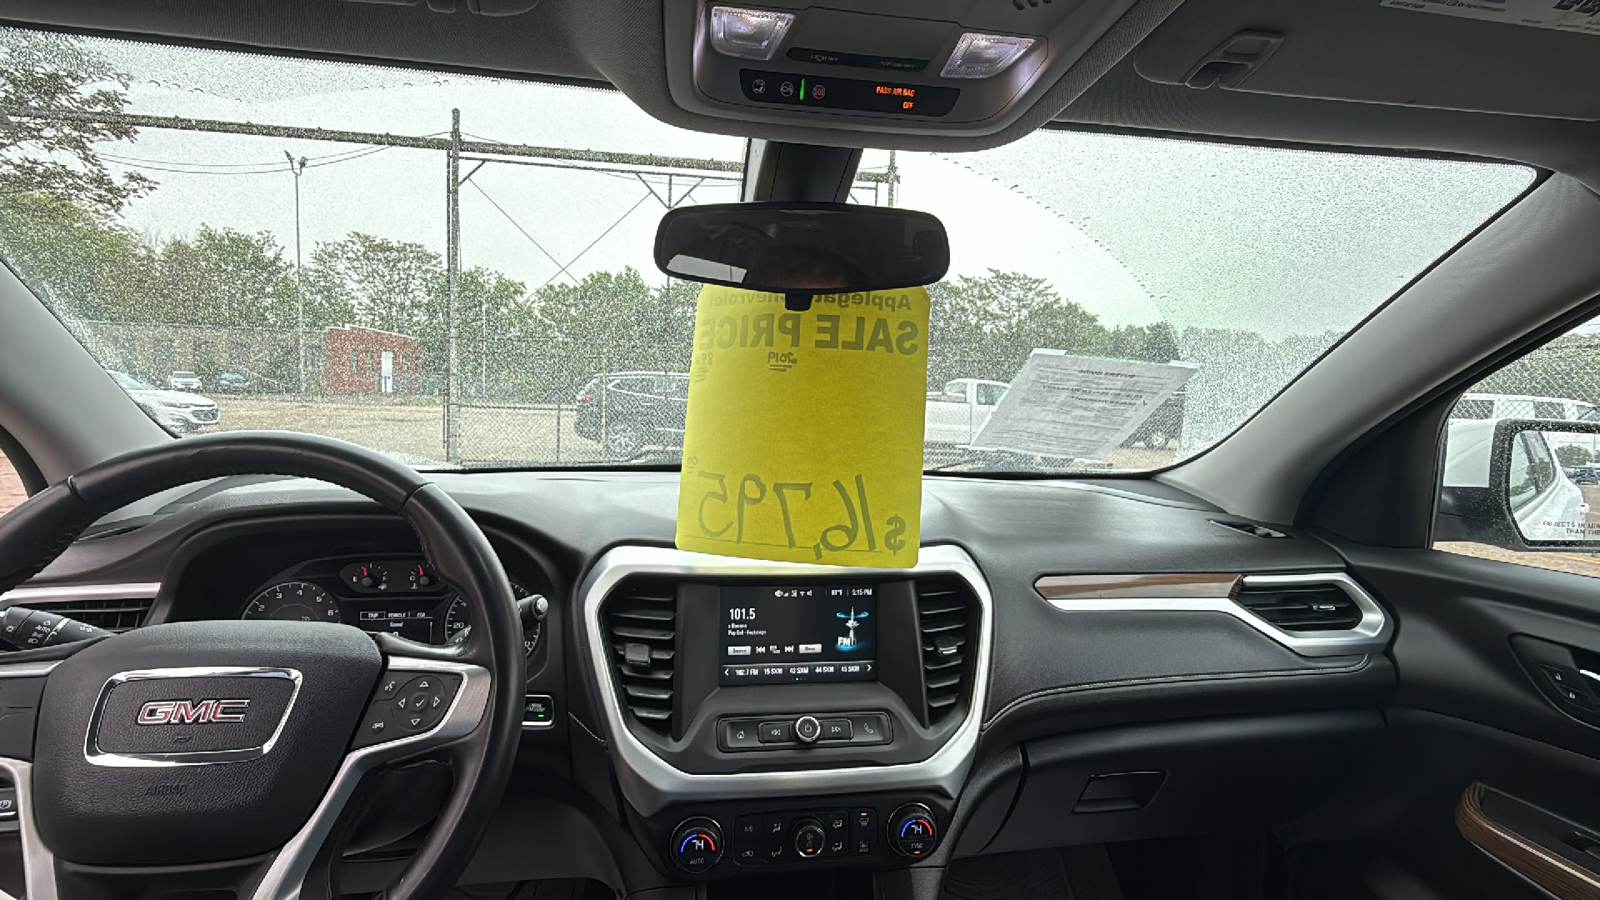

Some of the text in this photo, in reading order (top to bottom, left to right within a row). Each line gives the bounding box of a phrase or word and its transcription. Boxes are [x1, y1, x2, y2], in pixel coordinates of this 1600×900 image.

[876, 86, 915, 98] PASS AIR BAG
[902, 101, 914, 109] OFF
[863, 588, 873, 596] PM
[258, 604, 265, 612] 2
[729, 607, 756, 621] 101.5
[837, 636, 851, 648] FM
[749, 668, 759, 676] FM
[136, 699, 251, 724] GMC
[911, 824, 923, 835] 74
[691, 839, 704, 851] 74
[689, 857, 705, 865] AUTO
